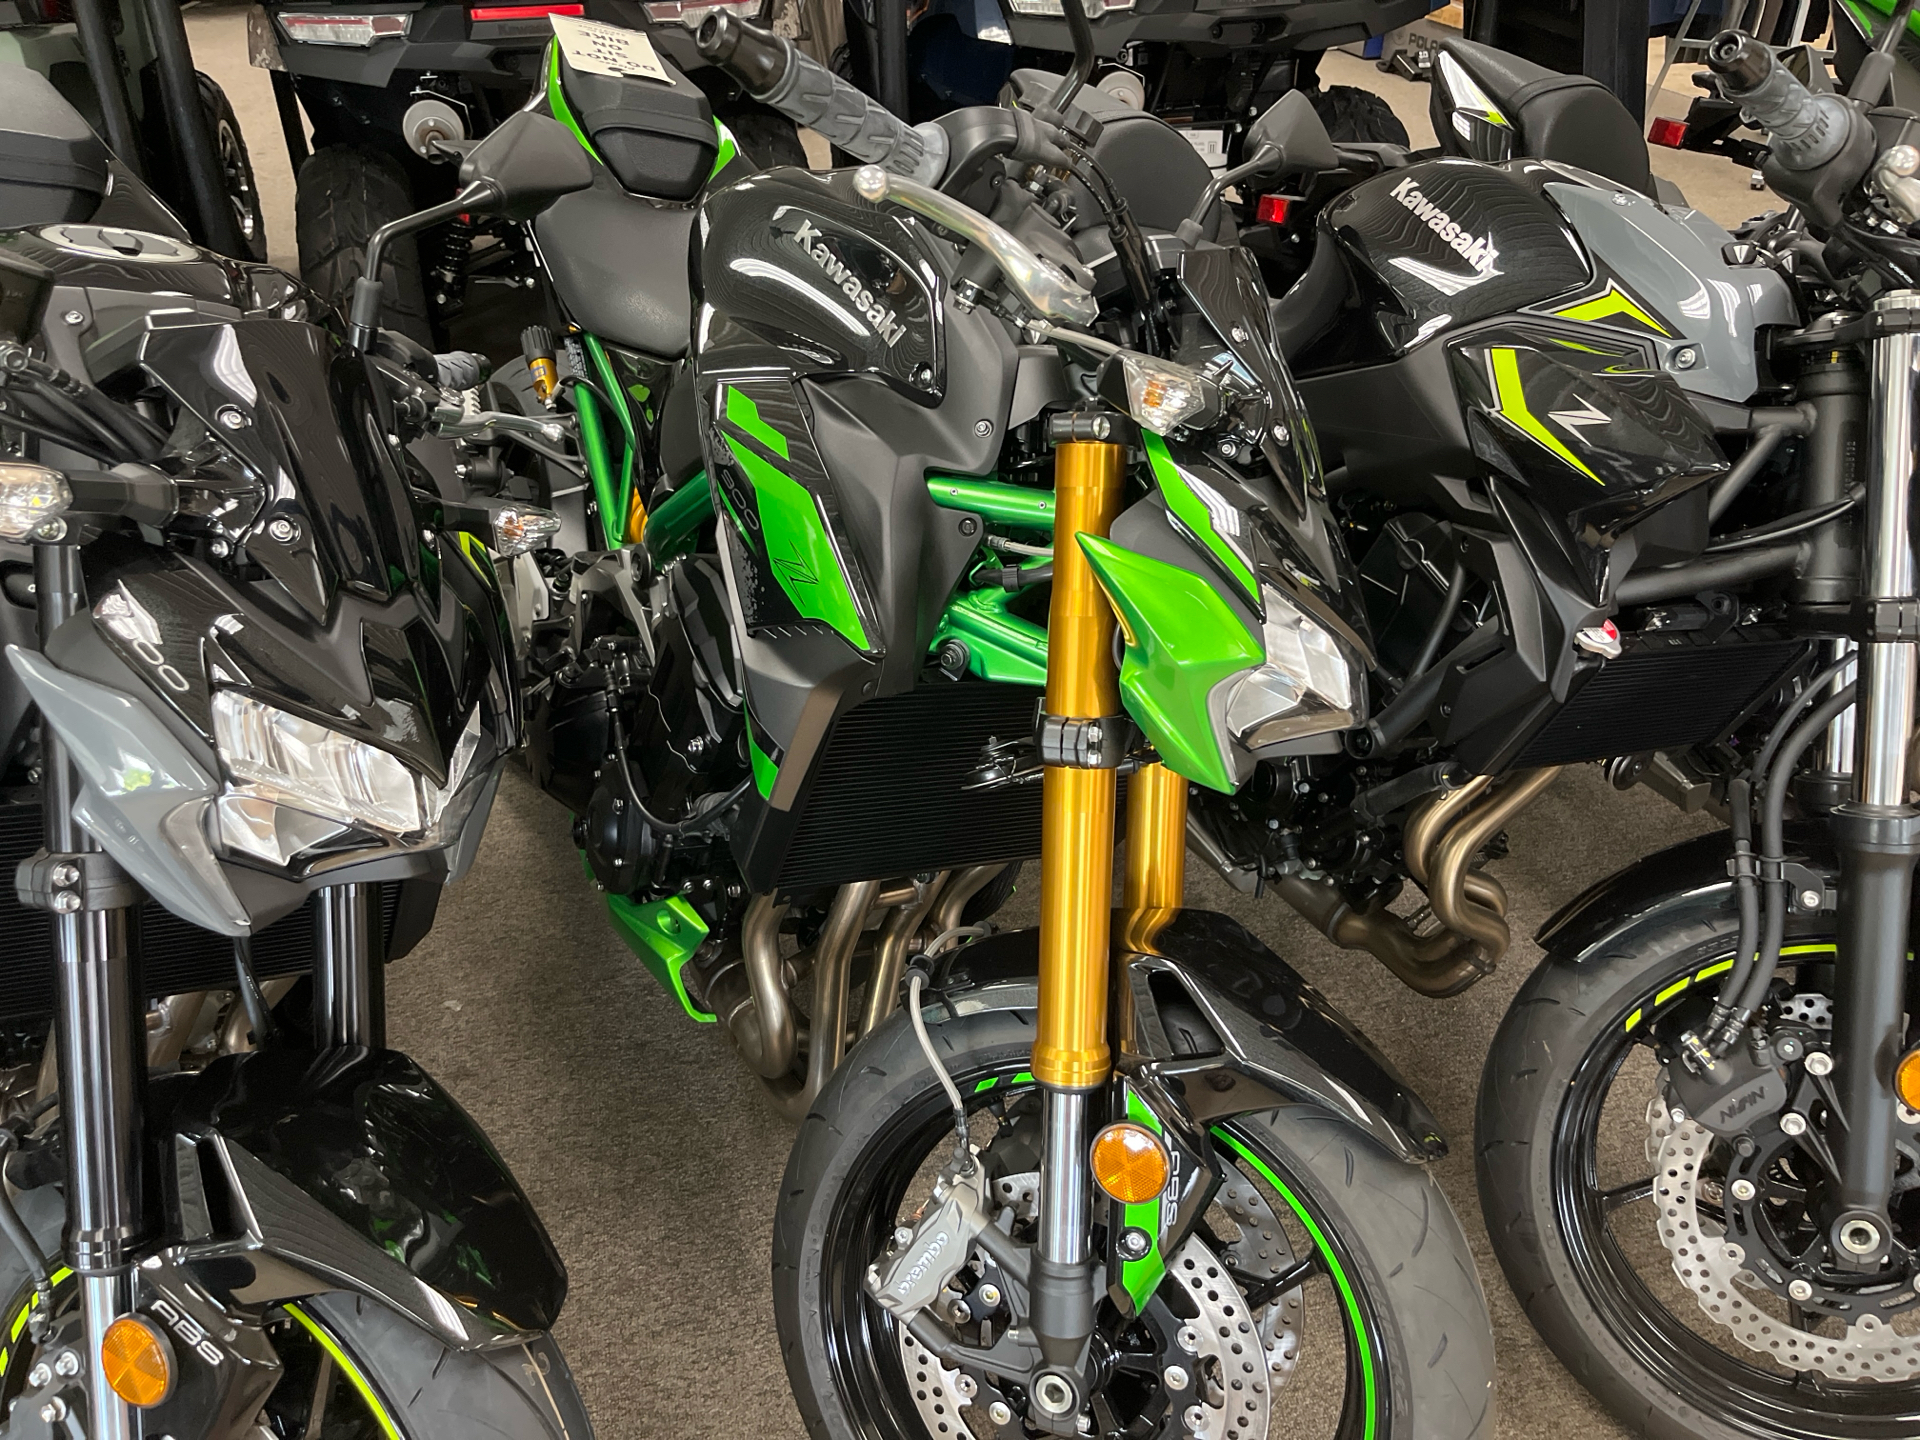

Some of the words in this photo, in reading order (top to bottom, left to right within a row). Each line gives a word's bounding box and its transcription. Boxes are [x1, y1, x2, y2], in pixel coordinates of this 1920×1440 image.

[572, 50, 618, 63] NOT
[577, 29, 630, 46] BIKE
[592, 40, 622, 50] ON
[594, 48, 628, 59] SIT
[1408, 32, 1438, 52] POLA
[626, 61, 657, 72] DO
[1389, 176, 1500, 272] Kawasaki
[793, 218, 907, 348] Kawasaki
[722, 468, 760, 531] 900
[1164, 1150, 1181, 1227] ABS
[897, 1231, 949, 1295] brembo
[150, 1299, 224, 1366] ABS
